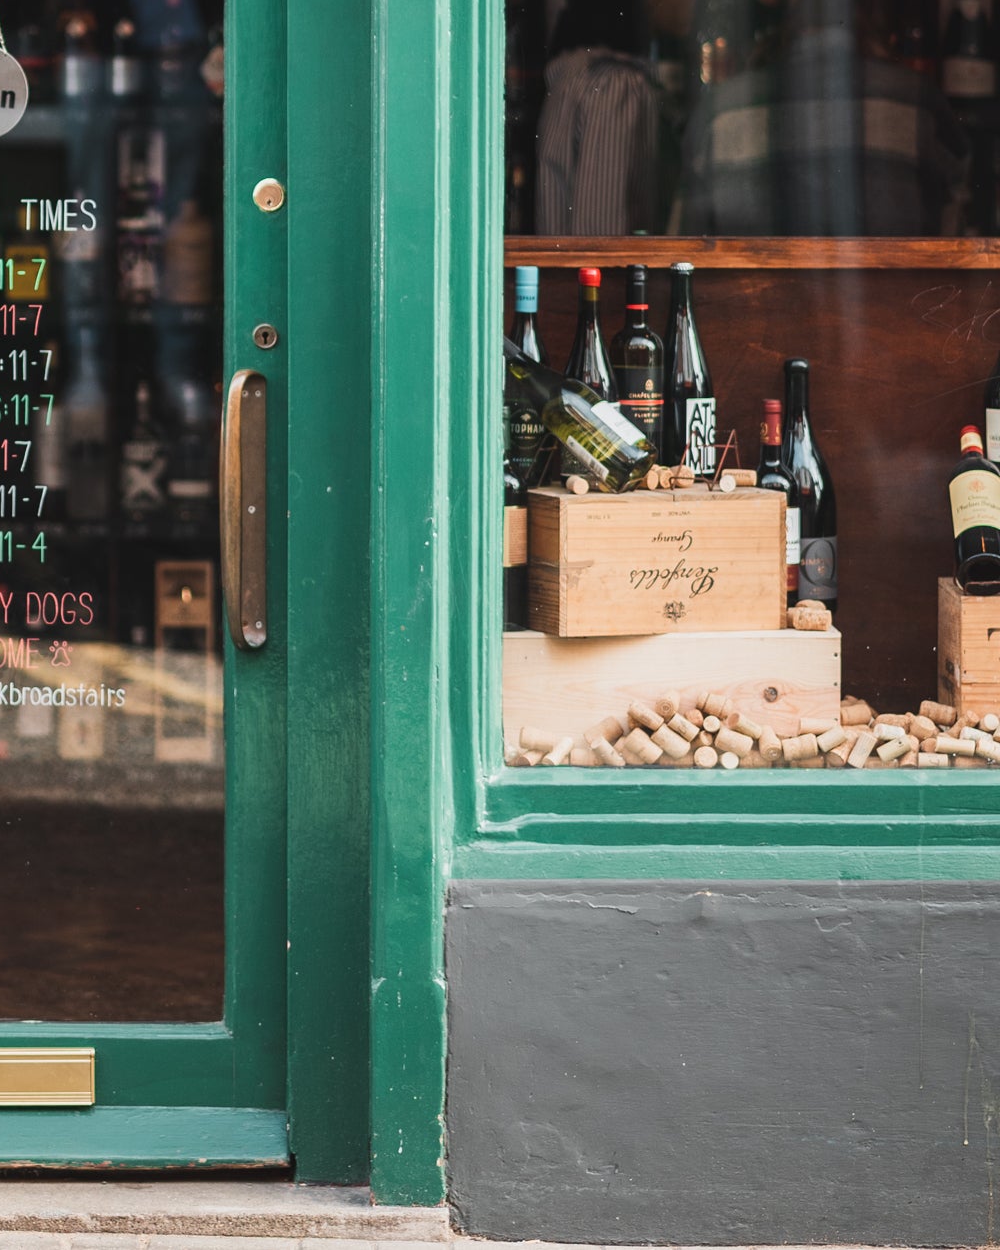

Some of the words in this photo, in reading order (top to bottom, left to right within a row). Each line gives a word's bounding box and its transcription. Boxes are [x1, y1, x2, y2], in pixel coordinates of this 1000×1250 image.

[20, 198, 98, 232] TIMES
[651, 529, 693, 552] Grange
[629, 558, 719, 599] Penfolds
[26, 591, 95, 626] DOGS
